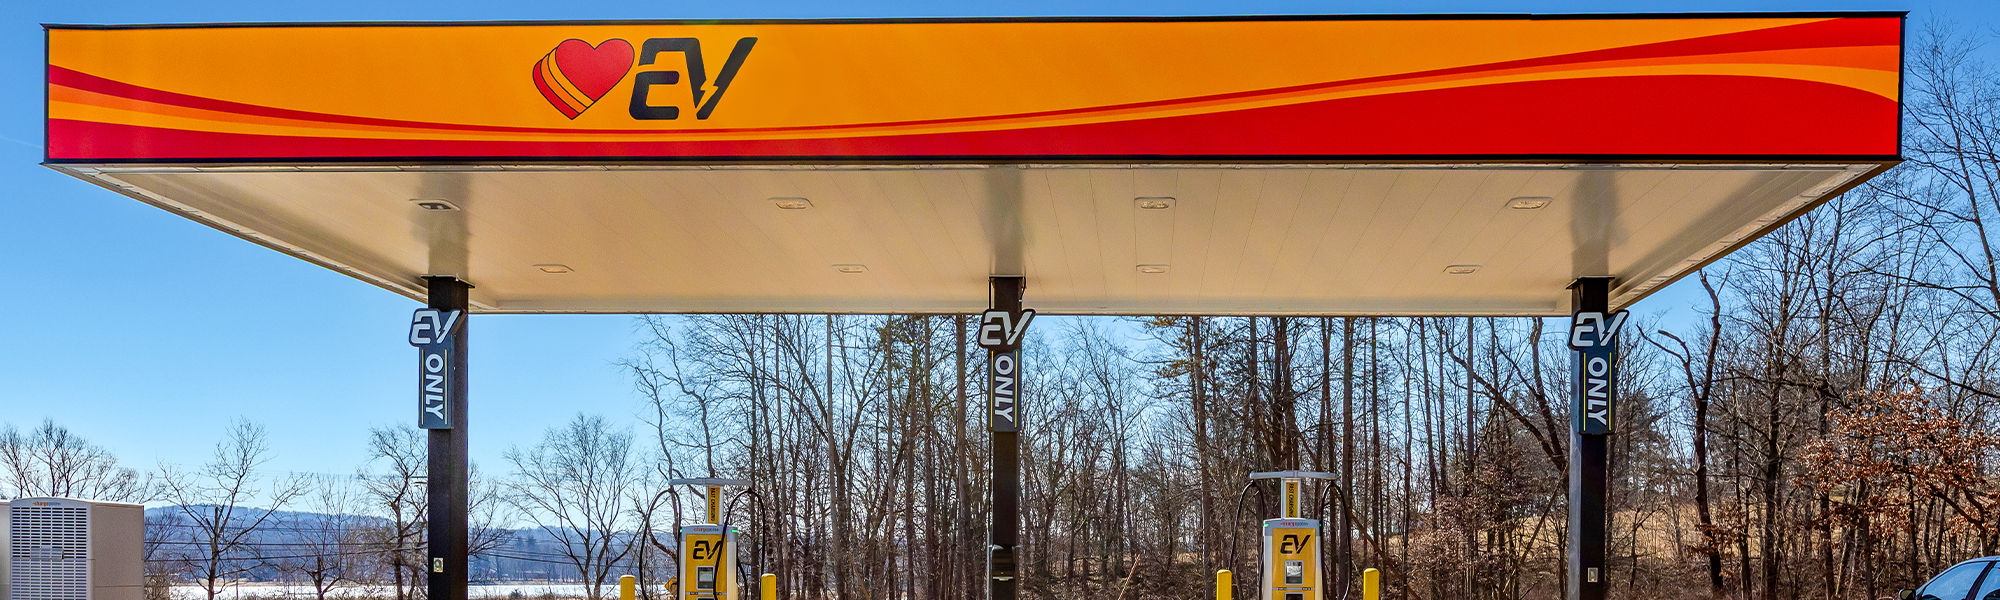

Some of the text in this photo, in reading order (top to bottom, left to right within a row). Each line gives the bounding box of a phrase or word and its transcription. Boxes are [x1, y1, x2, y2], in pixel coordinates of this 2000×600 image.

[629, 37, 758, 120] EV
[411, 310, 461, 344] EV
[980, 311, 1031, 346] EV
[1572, 312, 1627, 347] EV
[425, 353, 445, 420] ONLY
[994, 354, 1014, 423] ONLY
[1587, 357, 1608, 426] ONLY
[693, 540, 722, 560] EV
[1280, 534, 1311, 554] EV
